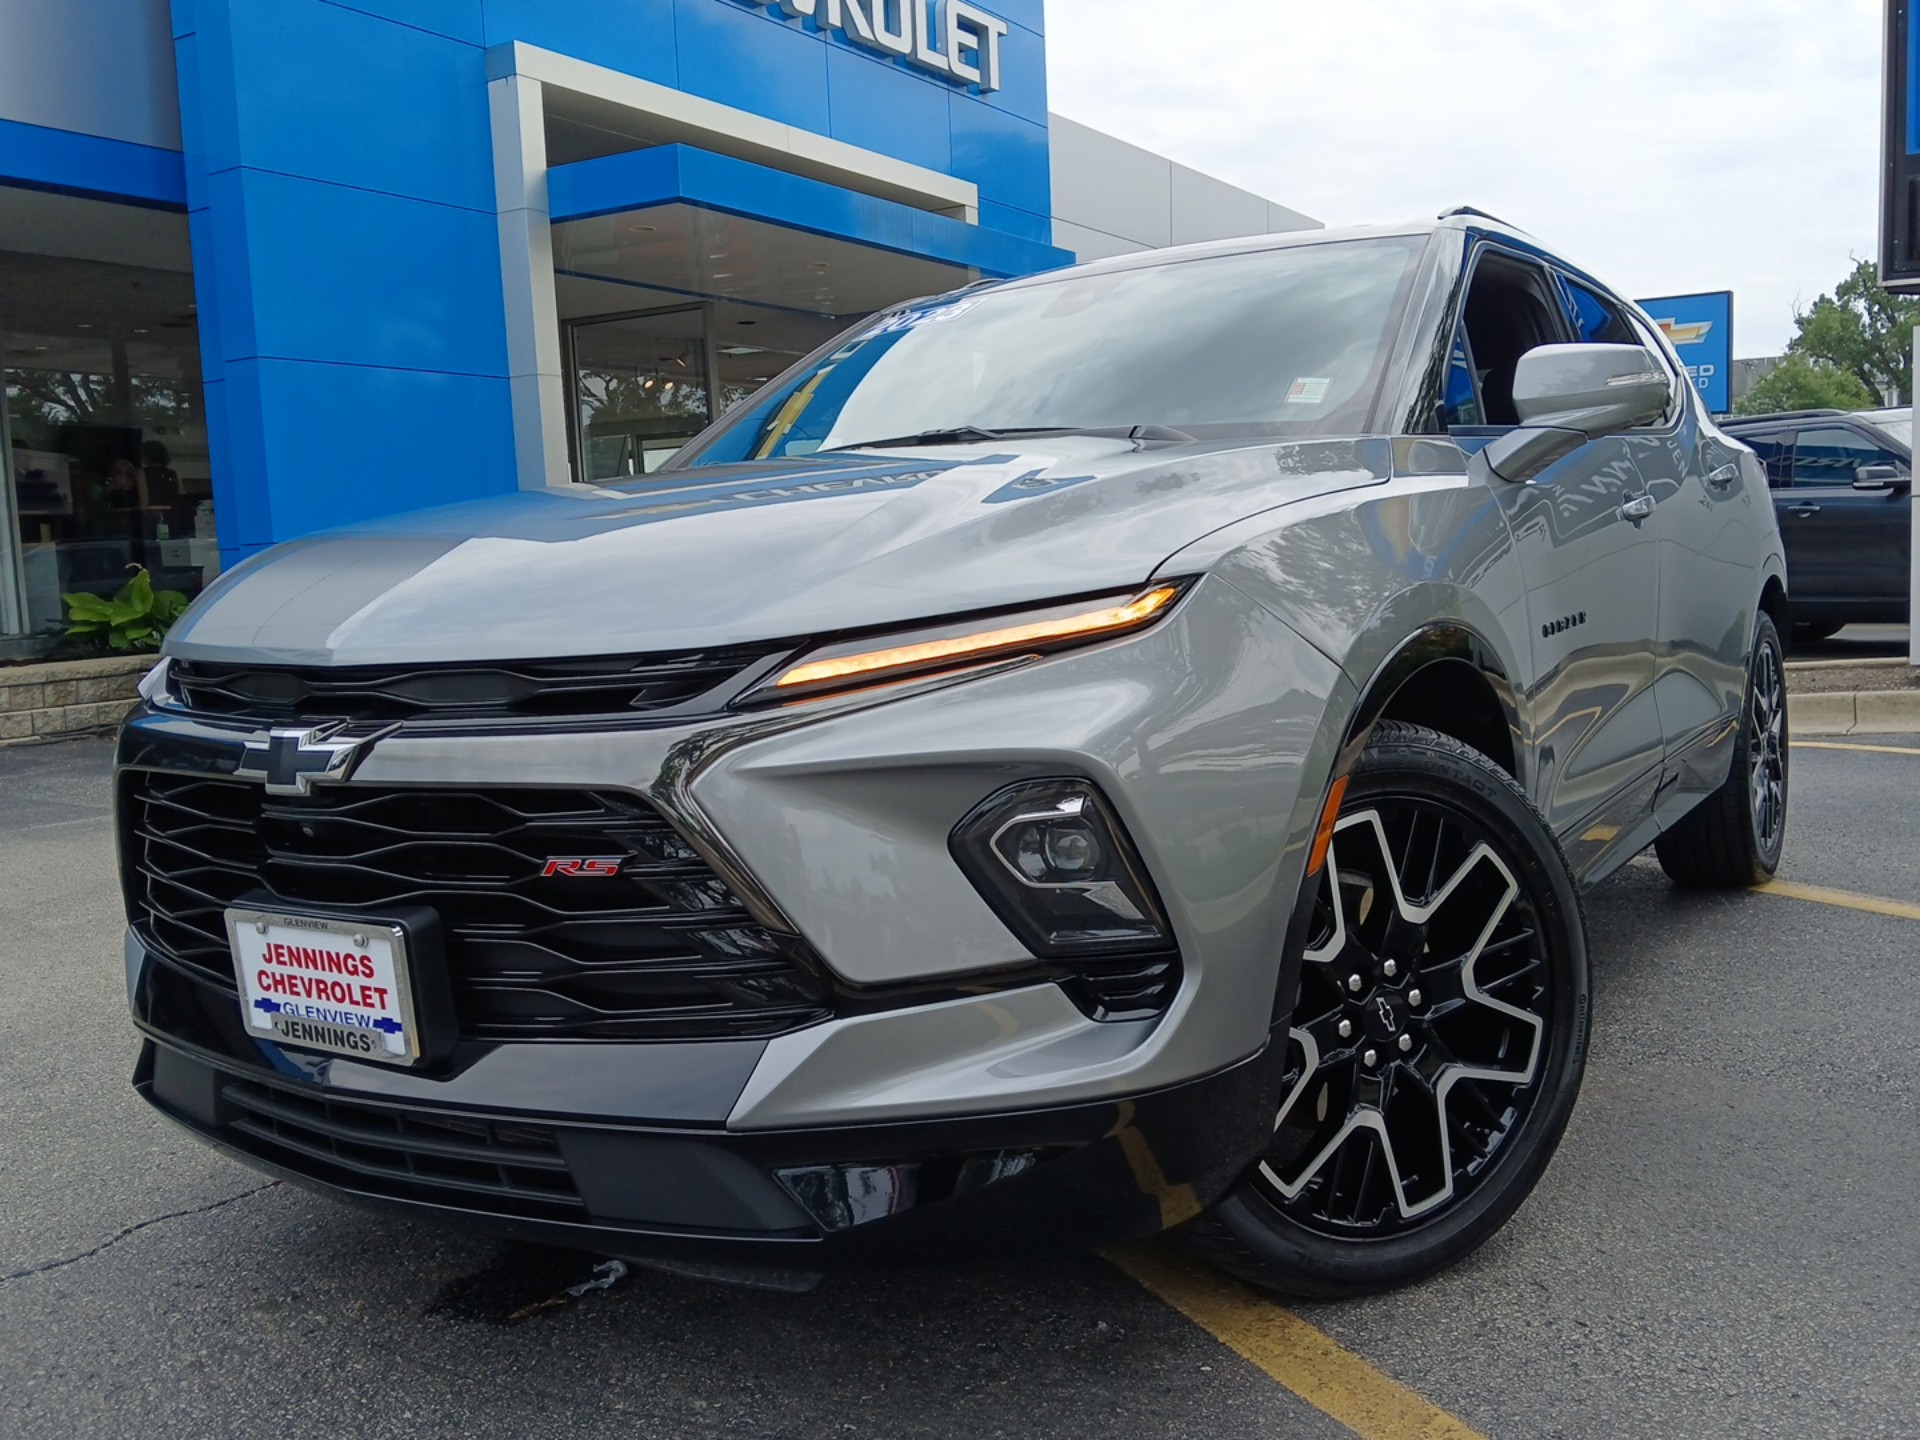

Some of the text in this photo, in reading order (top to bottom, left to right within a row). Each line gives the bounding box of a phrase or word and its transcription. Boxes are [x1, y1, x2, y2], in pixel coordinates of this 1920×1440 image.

[540, 858, 622, 877] RS
[283, 917, 328, 931] GLENVIEW
[262, 942, 375, 979] JENNINGS
[257, 969, 388, 1010] CHEVROLET
[283, 1001, 372, 1029] GLENVIEW
[281, 1019, 372, 1053] JENNINGS
